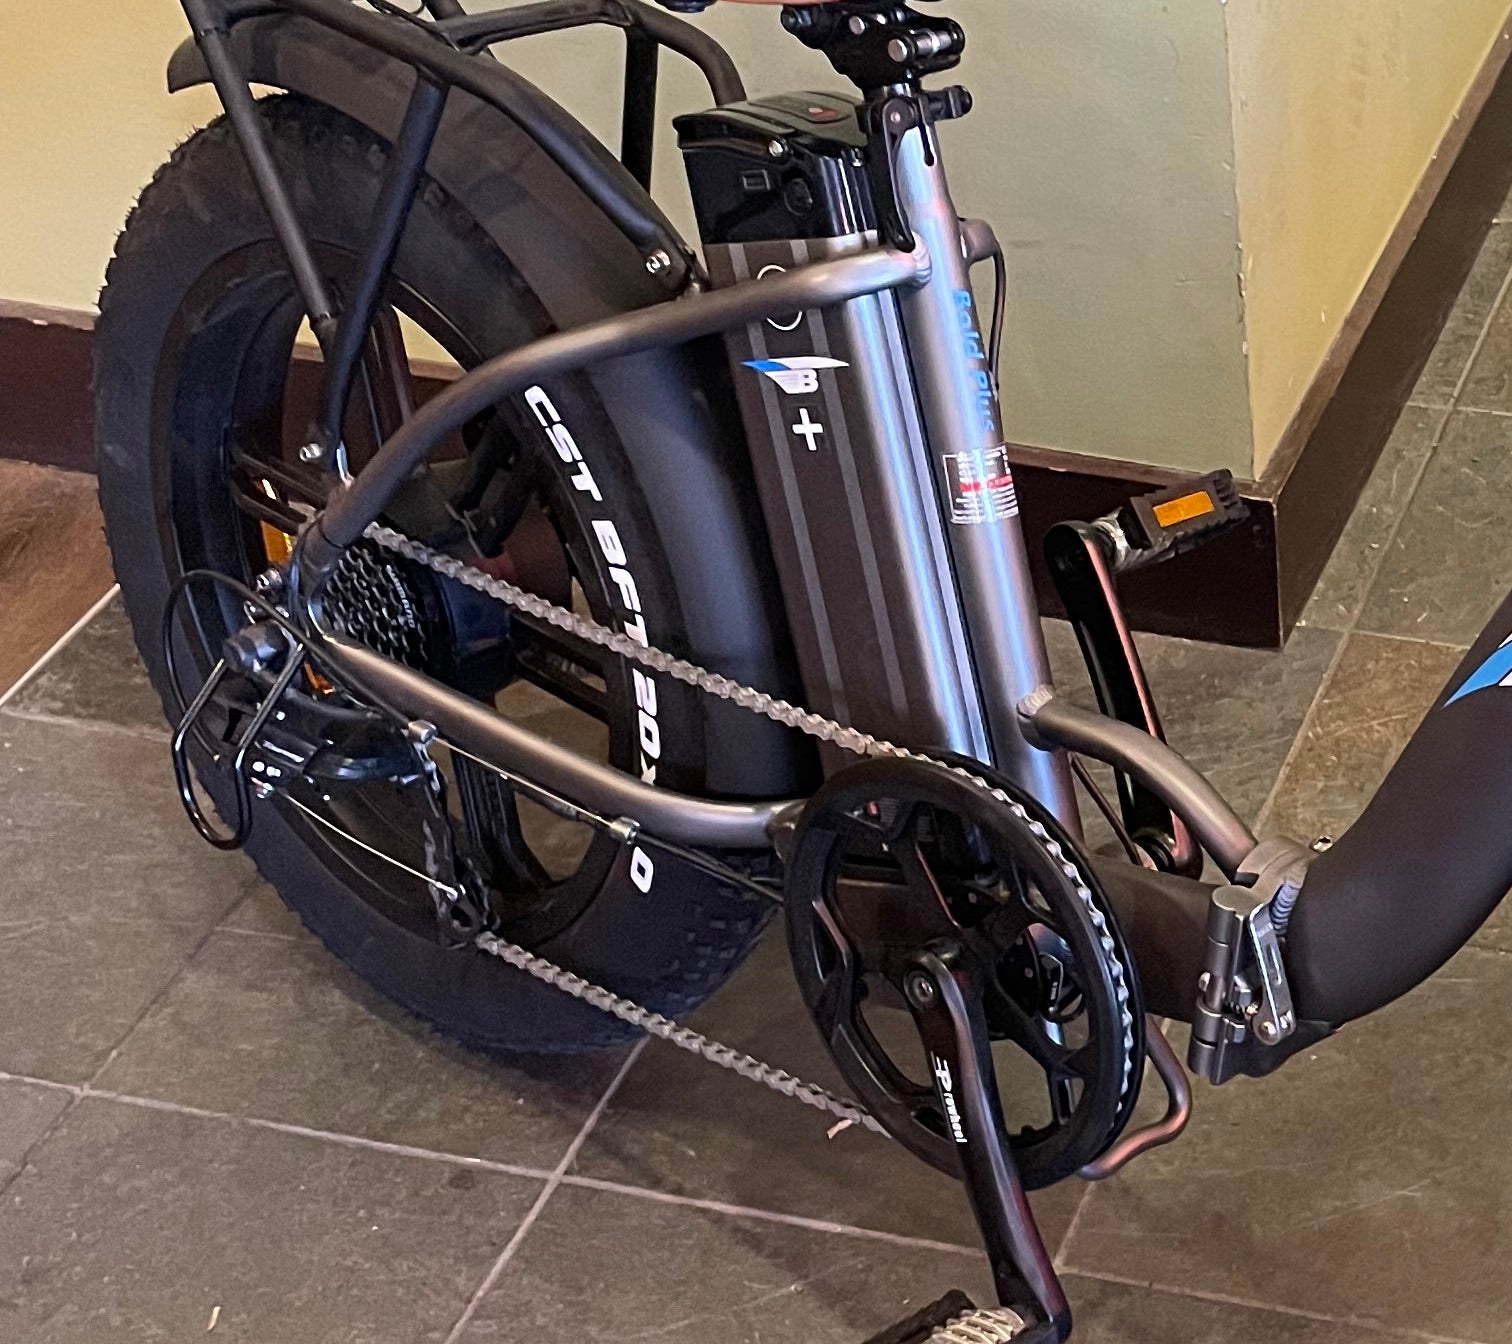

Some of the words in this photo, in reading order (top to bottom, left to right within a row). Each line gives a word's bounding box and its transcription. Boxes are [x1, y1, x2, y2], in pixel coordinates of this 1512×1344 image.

[952, 289, 985, 359] Bold
[971, 371, 994, 431] Plus
[524, 385, 603, 502] CST
[591, 519, 649, 648] BFT
